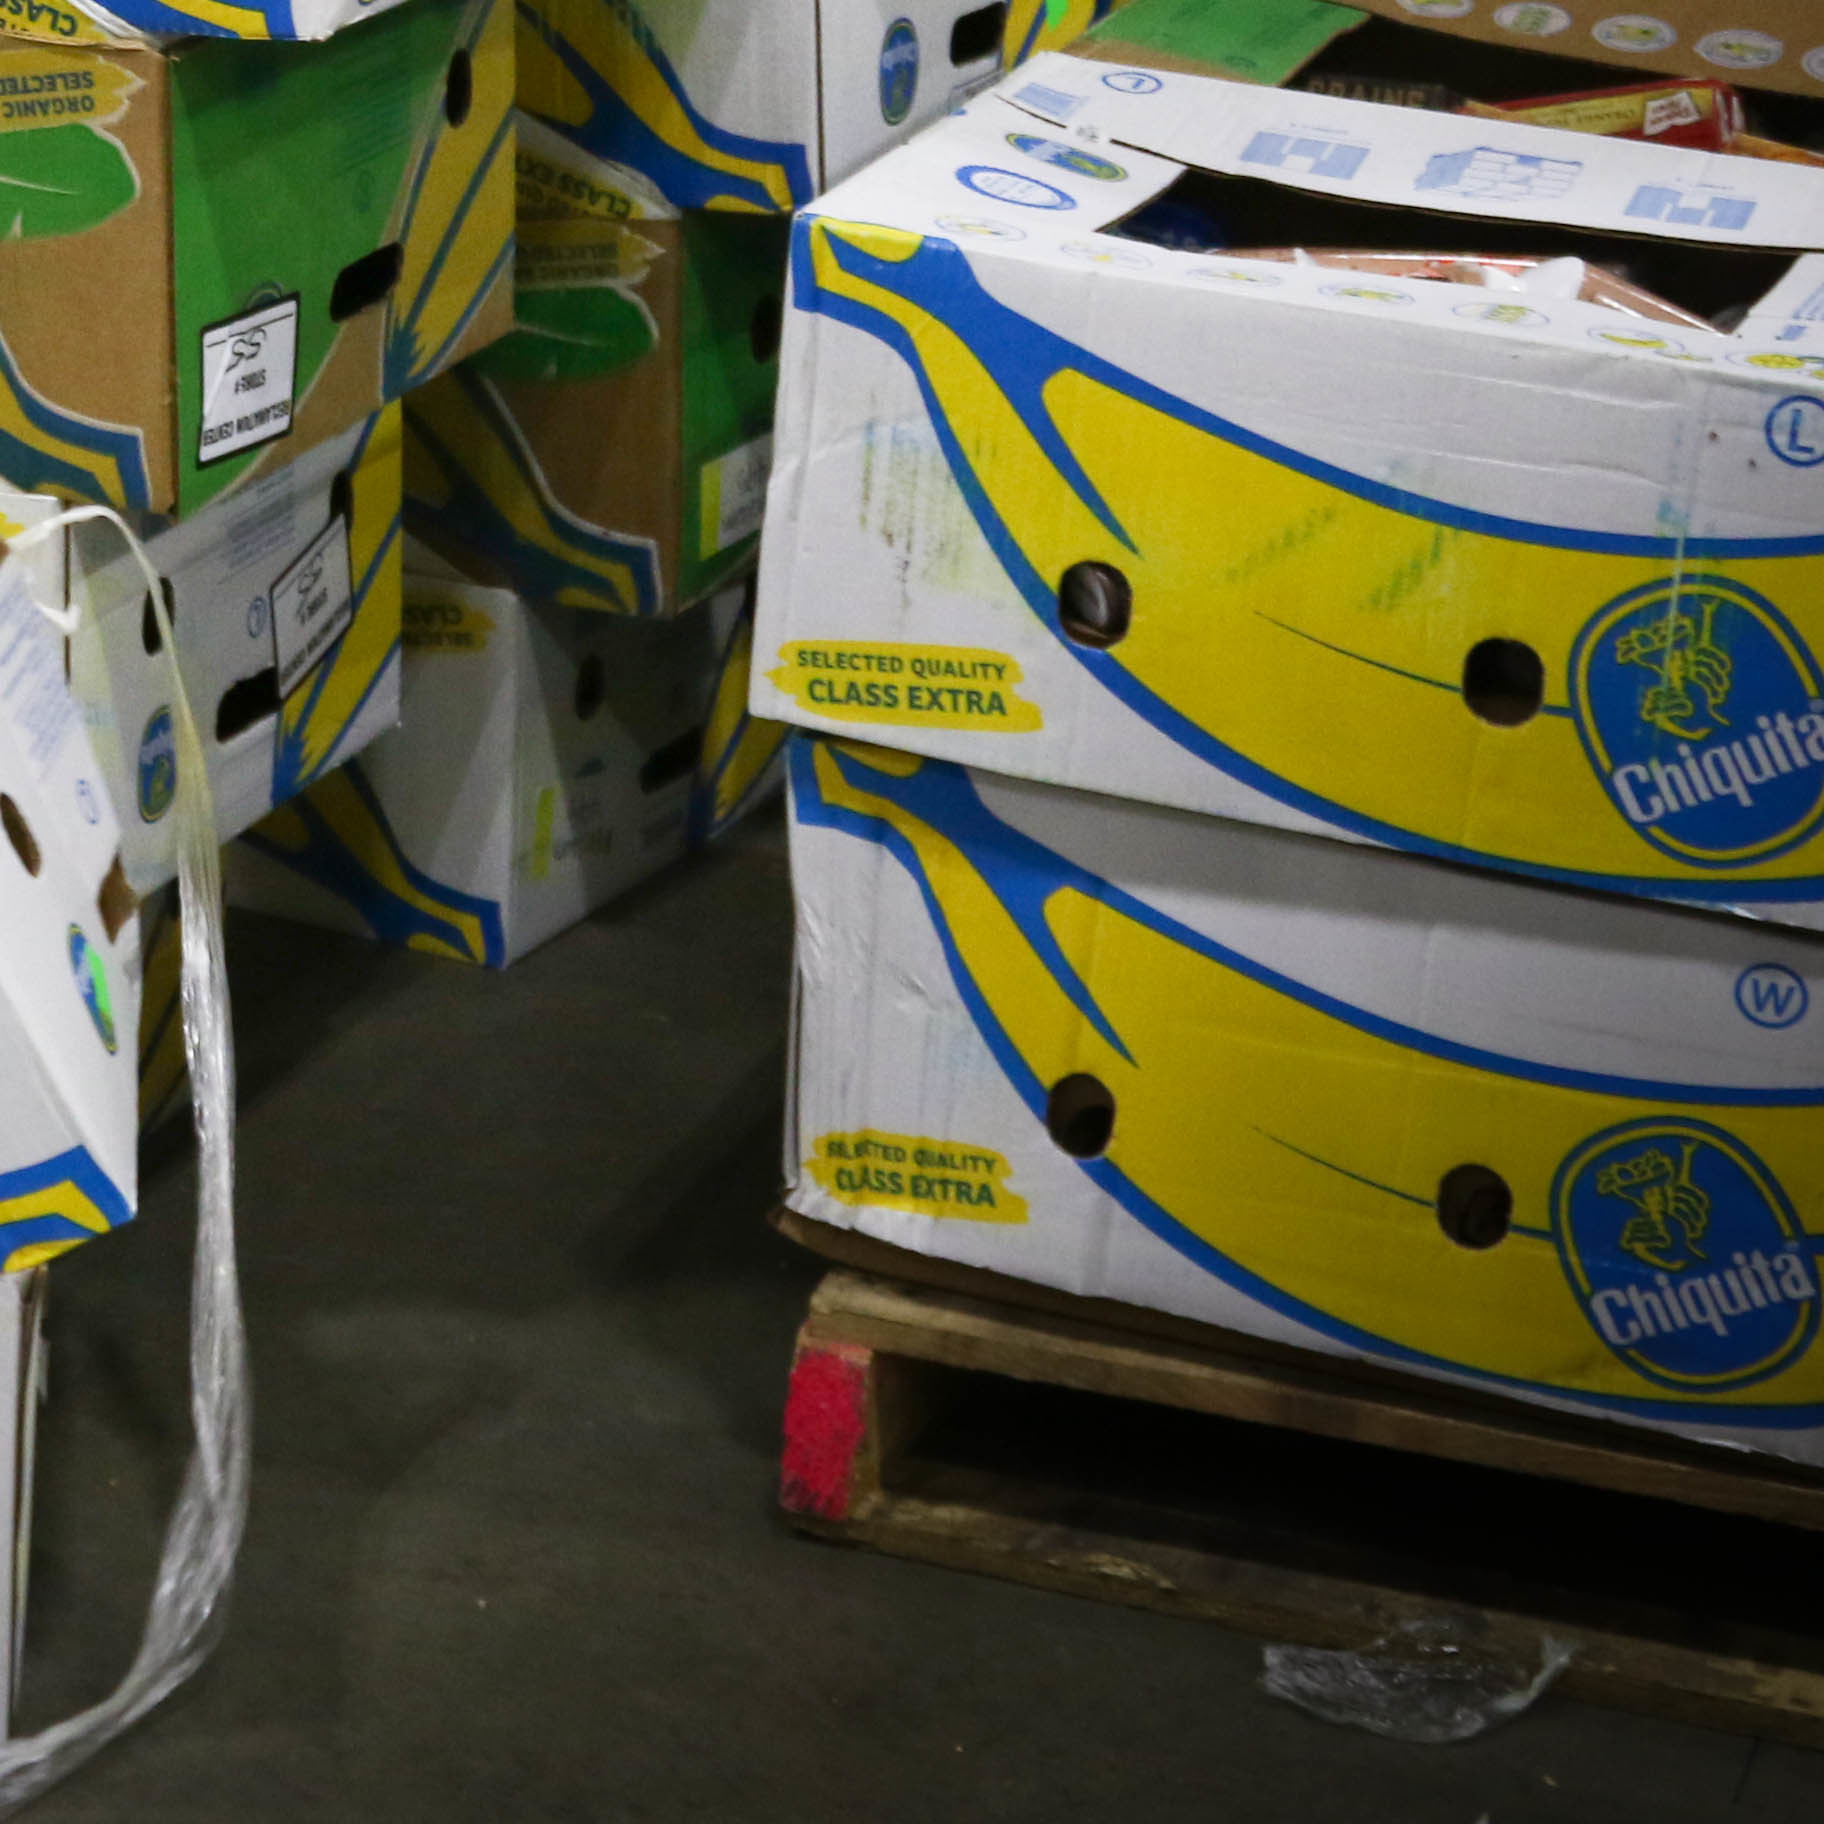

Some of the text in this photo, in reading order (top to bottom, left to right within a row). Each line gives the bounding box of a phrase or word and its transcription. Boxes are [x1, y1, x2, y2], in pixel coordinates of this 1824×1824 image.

[0, 95, 96, 119] ORGANIC
[797, 650, 1006, 681] SELECTED QUALITY
[808, 678, 1008, 716] CLASS EXTRA
[1613, 711, 1824, 823] Chiquita
[912, 1145, 997, 1175] QUALITY
[835, 1165, 997, 1208] CLASS EXTRA
[1590, 1251, 1815, 1345] Chiquita
